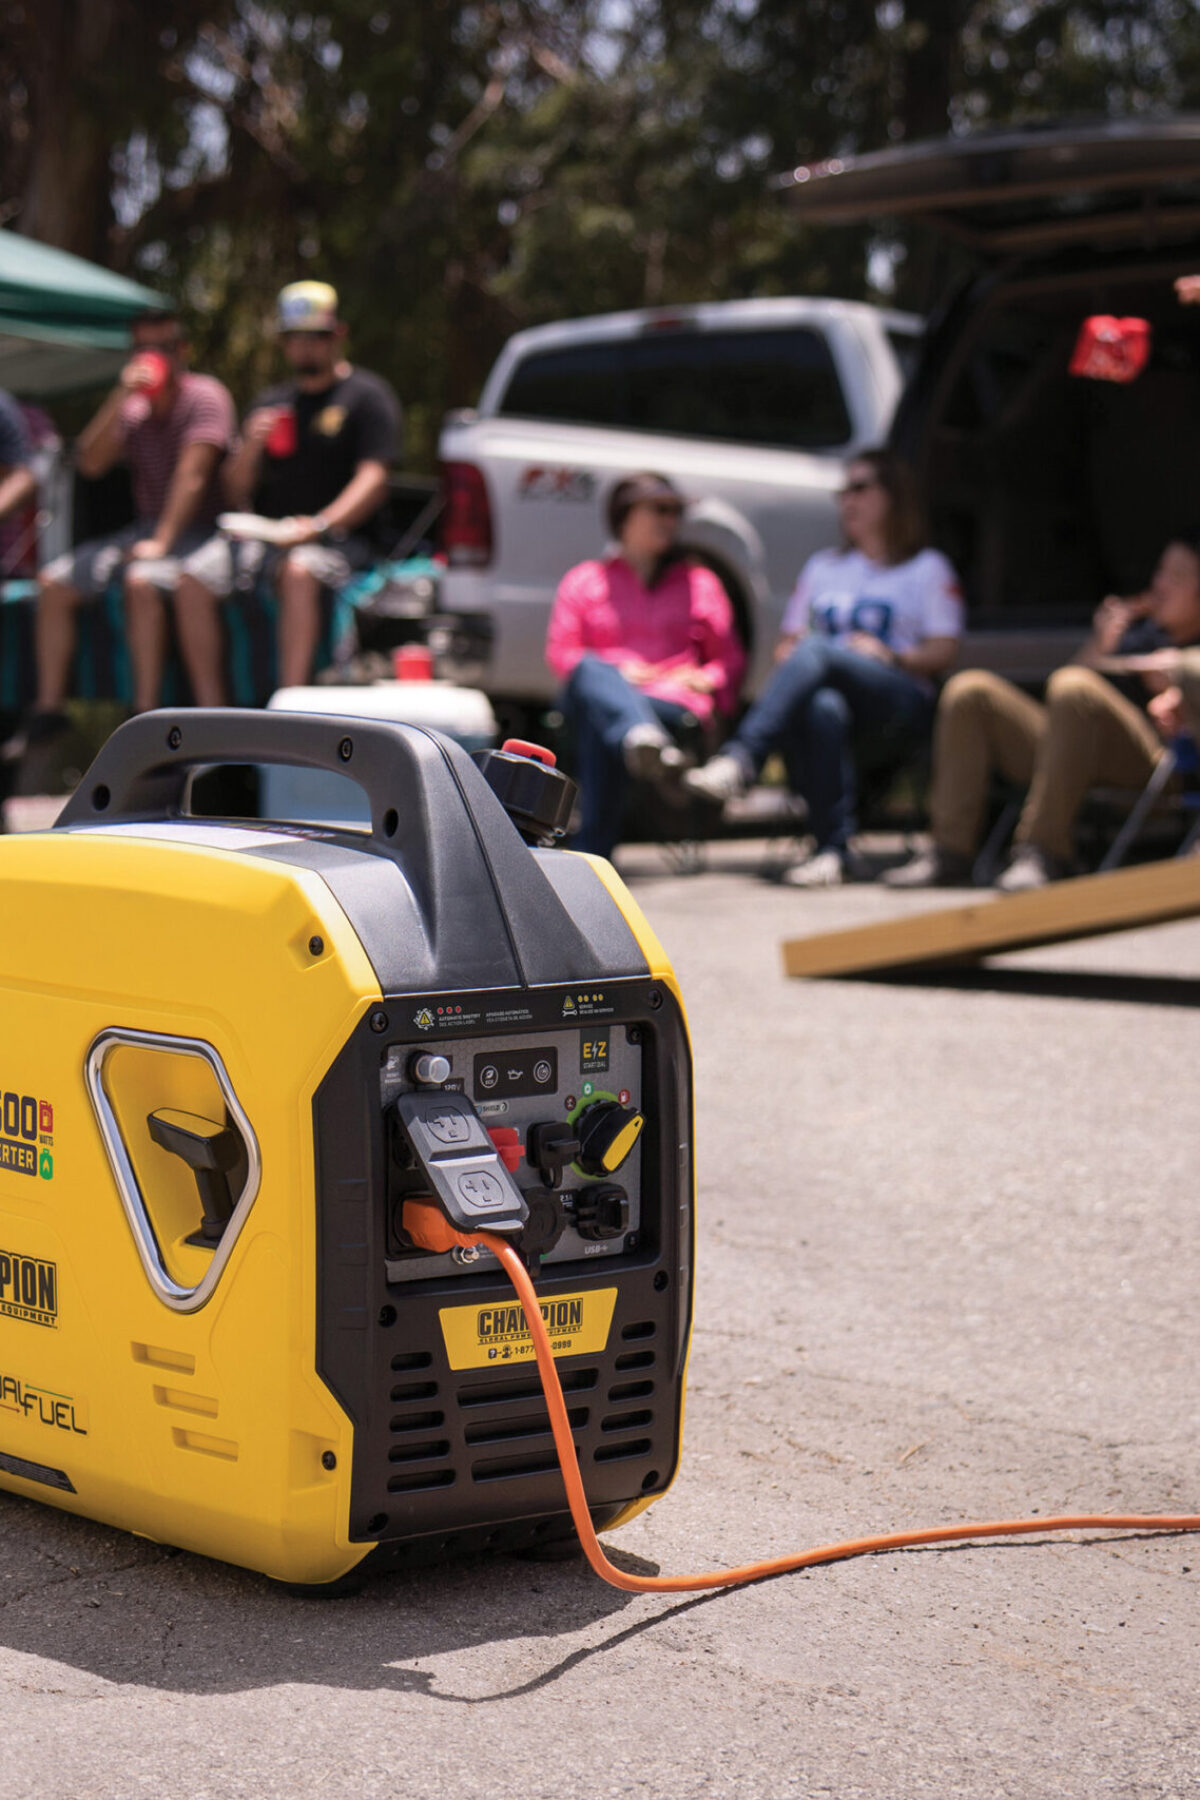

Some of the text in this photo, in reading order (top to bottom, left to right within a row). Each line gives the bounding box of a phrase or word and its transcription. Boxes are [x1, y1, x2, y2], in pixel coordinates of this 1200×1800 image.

[0, 1090, 37, 1141] 00
[0, 1143, 34, 1170] RTER
[1, 1303, 55, 1325] EQUIPMENT
[24, 1393, 87, 1435] FUEL
